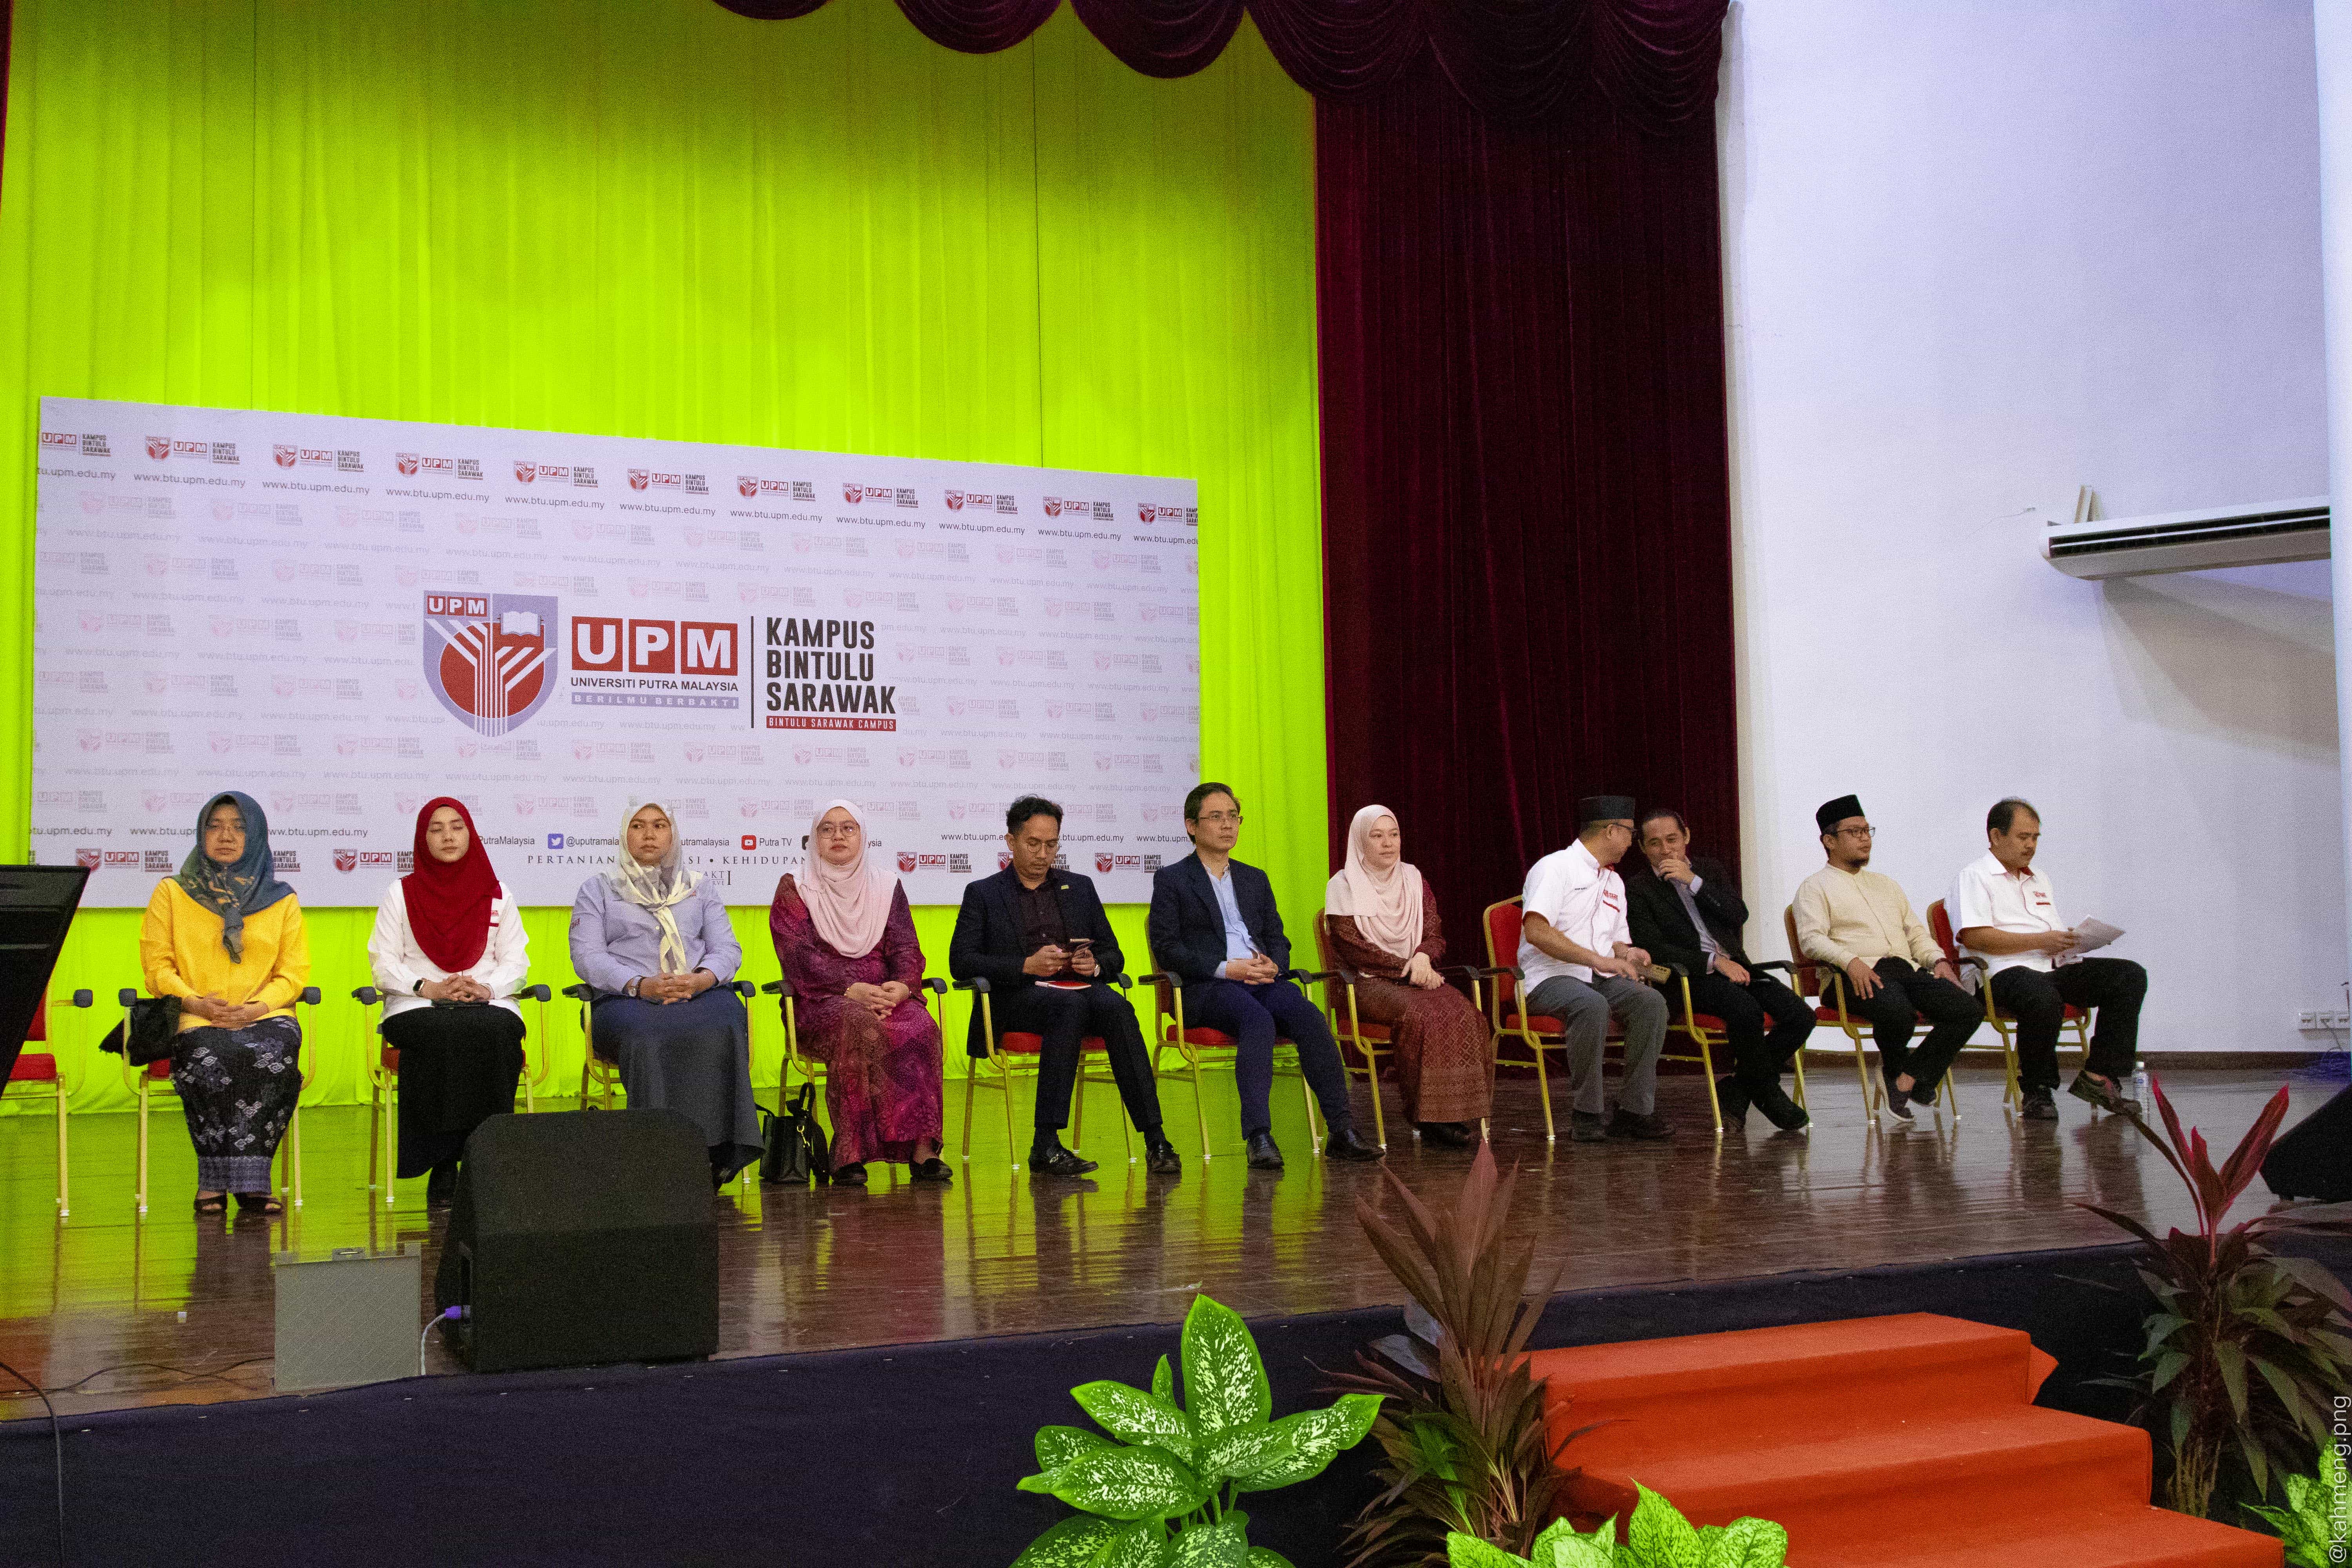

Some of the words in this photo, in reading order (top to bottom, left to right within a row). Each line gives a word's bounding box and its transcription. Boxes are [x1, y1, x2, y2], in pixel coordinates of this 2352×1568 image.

[42, 432, 76, 444] UPM
[174, 441, 207, 452] UPM
[301, 450, 332, 461] UPM
[422, 458, 452, 468] UPM
[539, 466, 568, 476] UPM
[134, 474, 245, 488] www.btu.upm.edu.my
[652, 473, 680, 484] UPM
[263, 481, 370, 495] www.btu.upm.edu.my
[761, 481, 788, 491] UPM
[386, 489, 489, 503] www.btu.upm.edu.my
[866, 488, 892, 497] UPM
[505, 497, 604, 510] www.btu.upm.edu.my
[967, 494, 992, 504] UPM
[620, 504, 715, 517] www.btu.upm.edu.my
[1064, 501, 1089, 511] UPM
[730, 510, 822, 523] www.btu.upm.edu.my
[1159, 507, 1182, 517] UPM
[837, 517, 926, 529] www.btu.upm.edu.my
[939, 523, 1025, 535] www.btu.upm.edu.my
[1038, 530, 1121, 541] www.btu.upm.edu.my
[428, 596, 487, 616] UPM
[767, 617, 874, 649] KAMPUS
[572, 617, 738, 676] UPM
[767, 649, 873, 682] BINTULU
[571, 677, 635, 688] UNIVERSITI
[639, 679, 678, 690] PUTRA
[682, 681, 738, 691] MALAYSIA
[575, 695, 646, 704] BERILMU
[655, 697, 735, 706] BERBAKTI
[767, 682, 896, 714] SARAWAK
[769, 717, 806, 727] BINTULU
[811, 719, 853, 728] SARAWAK
[858, 720, 893, 730] CAMPUS
[269, 828, 368, 838] ww.btu.upm.edu.my
[1058, 834, 1124, 843] .btu.upm.edu.my
[681, 837, 730, 848] utramalaysia
[759, 838, 779, 846] Putra
[781, 838, 792, 846] TV
[868, 839, 882, 848] ysia
[105, 852, 138, 862] UPM
[360, 853, 391, 862] UPM
[528, 855, 615, 864] PERTANIAN
[919, 855, 945, 864] UPM
[1116, 856, 1140, 864] UPM
